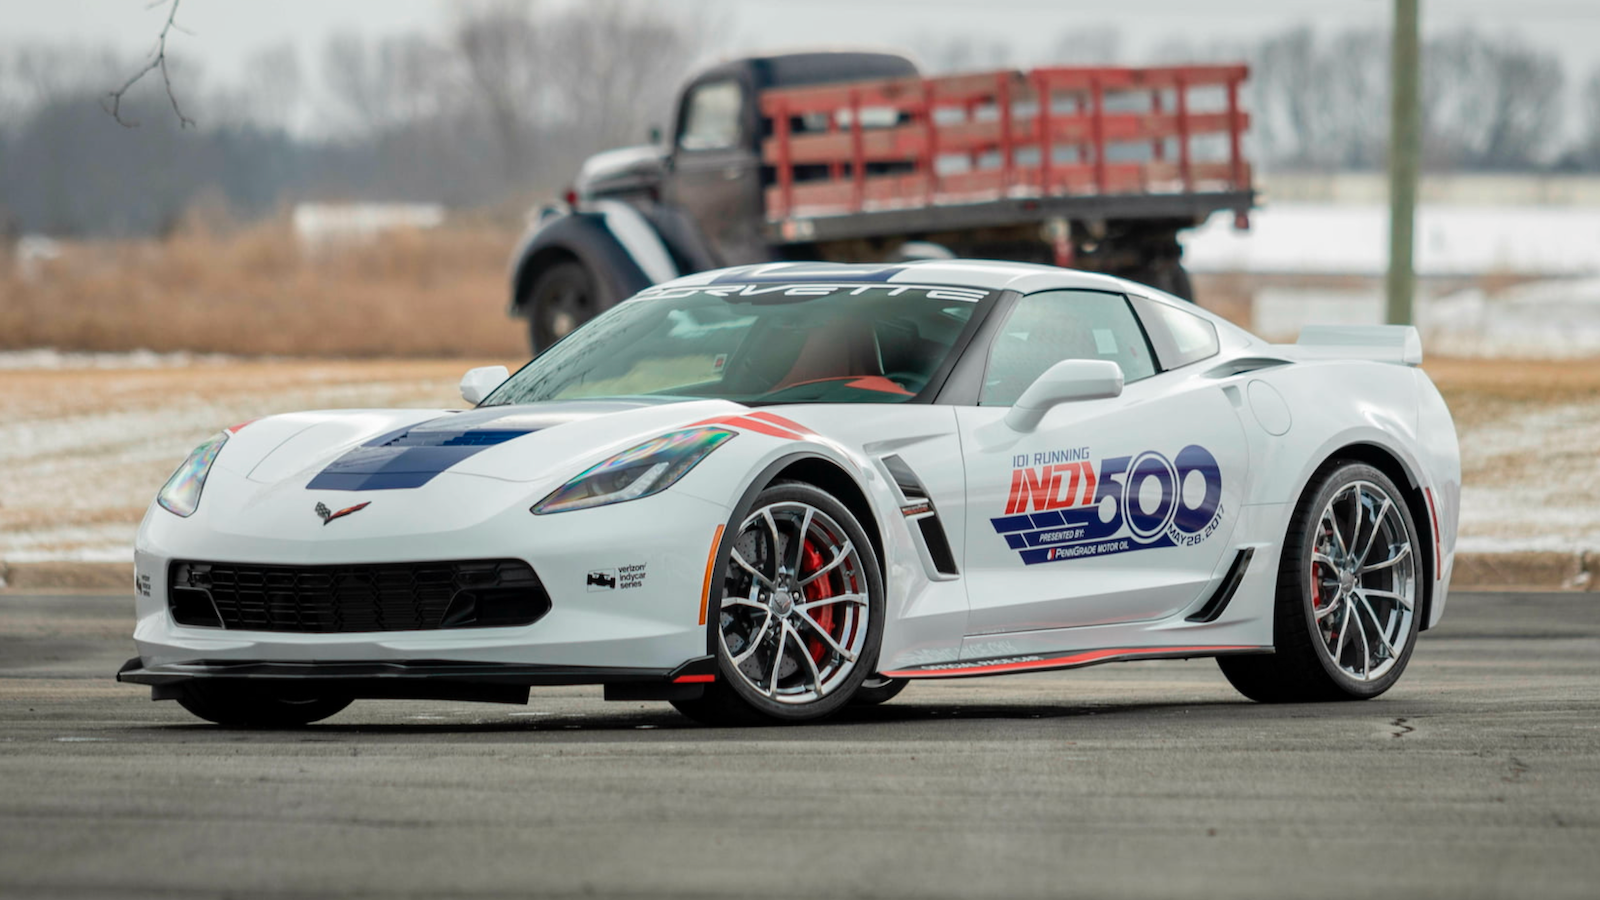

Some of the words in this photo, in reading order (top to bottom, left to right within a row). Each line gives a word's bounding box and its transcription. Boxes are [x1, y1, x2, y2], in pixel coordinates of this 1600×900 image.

[1034, 447, 1090, 465] RUNNING
[1004, 461, 1097, 515] INDY
[1094, 444, 1222, 541] 500
[1167, 523, 1187, 545] MAY
[1204, 503, 1225, 538] 2017
[1039, 531, 1075, 542] PRESENTED
[1074, 529, 1086, 538] BY:
[1097, 542, 1119, 553] MOTOR
[1119, 541, 1130, 550] OIL
[620, 572, 647, 582] indycar
[620, 581, 642, 589] series
